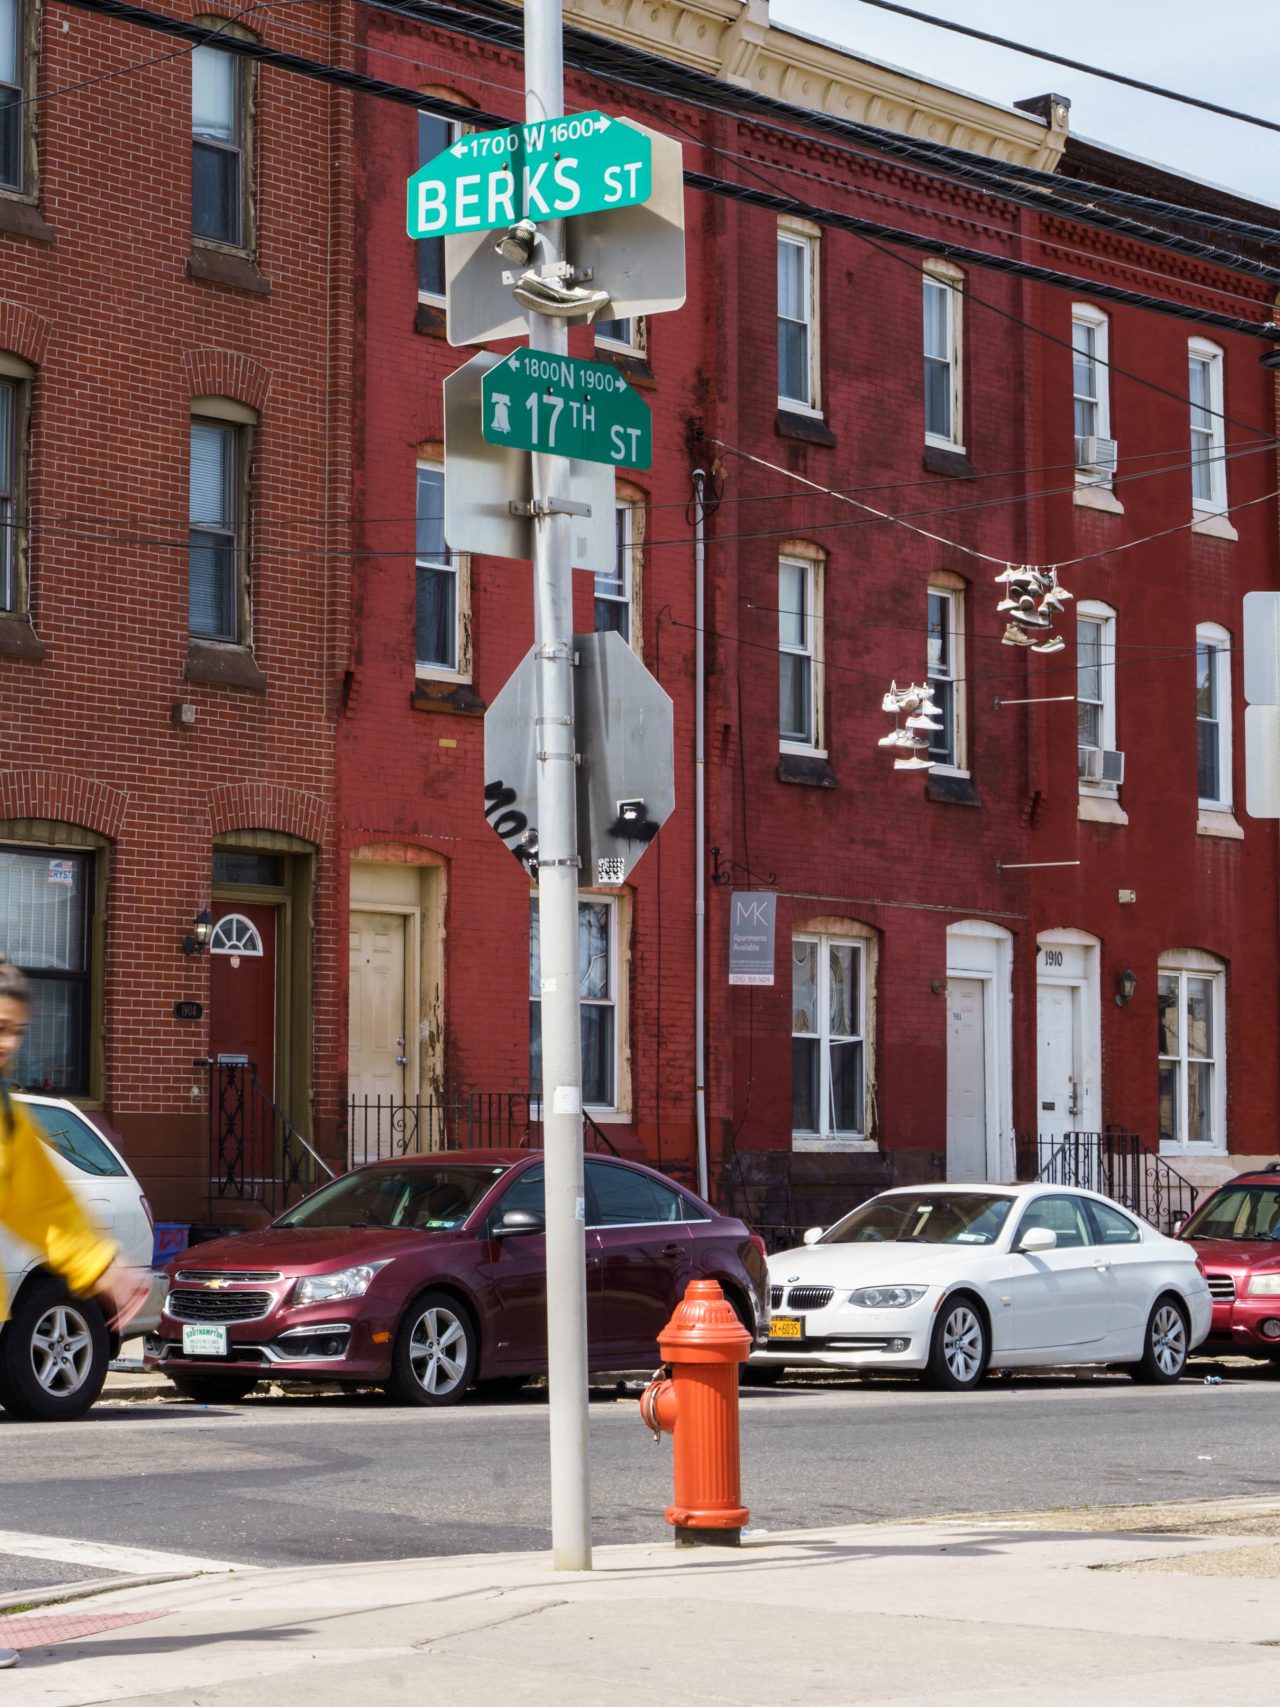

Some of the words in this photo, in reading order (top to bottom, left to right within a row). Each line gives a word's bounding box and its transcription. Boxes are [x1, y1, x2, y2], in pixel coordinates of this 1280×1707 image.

[470, 134, 518, 158] 1700
[524, 124, 545, 153] W
[549, 118, 595, 143] 1600
[417, 157, 581, 233] BERKS
[603, 161, 643, 203] ST
[523, 357, 560, 381] 1800
[560, 361, 575, 390] N
[579, 369, 615, 393] 1900
[525, 391, 596, 447] 17TH
[609, 424, 642, 462] ST
[737, 902, 768, 926] MK
[733, 934, 768, 943] Apartments
[1044, 950, 1063, 967] 1910
[186, 1328, 224, 1339] SOUTHAMPTON
